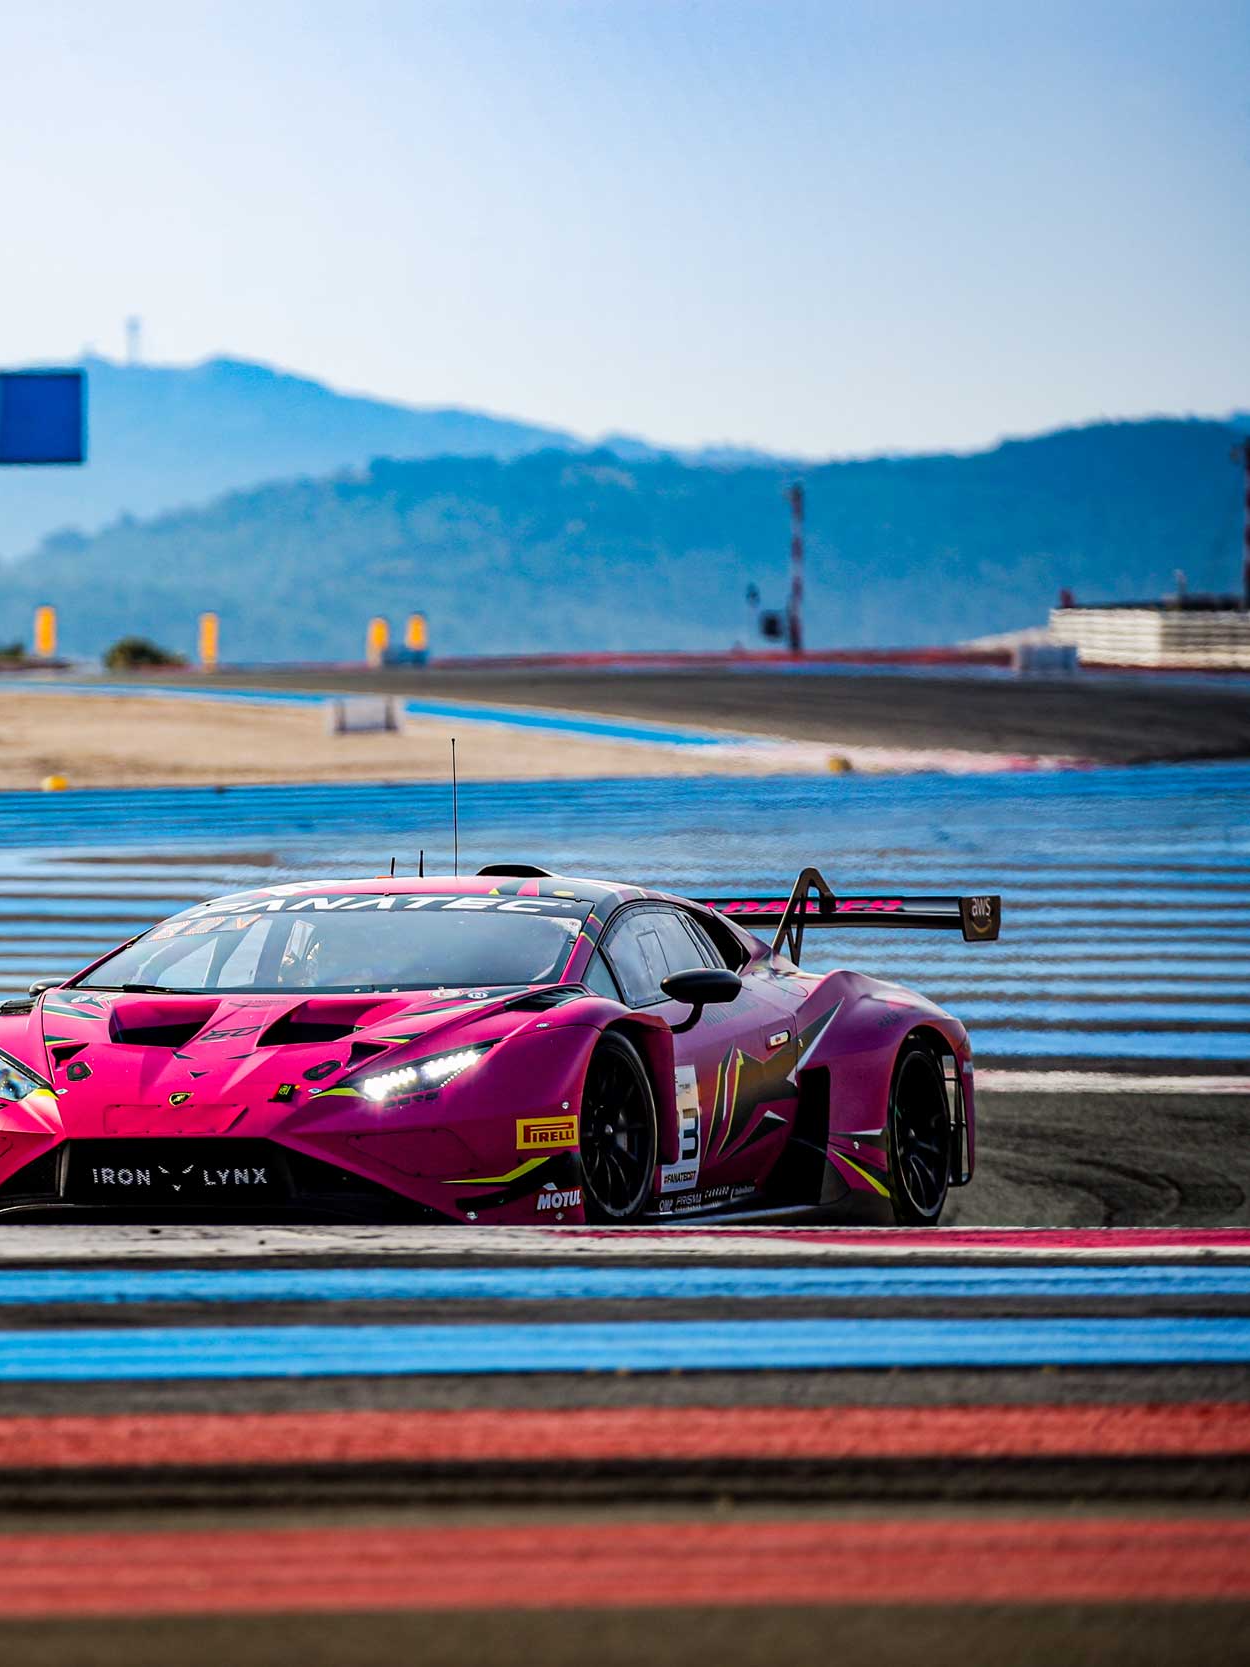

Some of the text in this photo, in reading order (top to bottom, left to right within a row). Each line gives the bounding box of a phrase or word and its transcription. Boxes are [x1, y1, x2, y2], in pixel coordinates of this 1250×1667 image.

[187, 896, 560, 919] FANATEC
[972, 897, 991, 917] aws
[523, 1122, 574, 1143] PIRELLI
[92, 1168, 268, 1185] IRON LYNX
[536, 1189, 582, 1211] MOTUL
